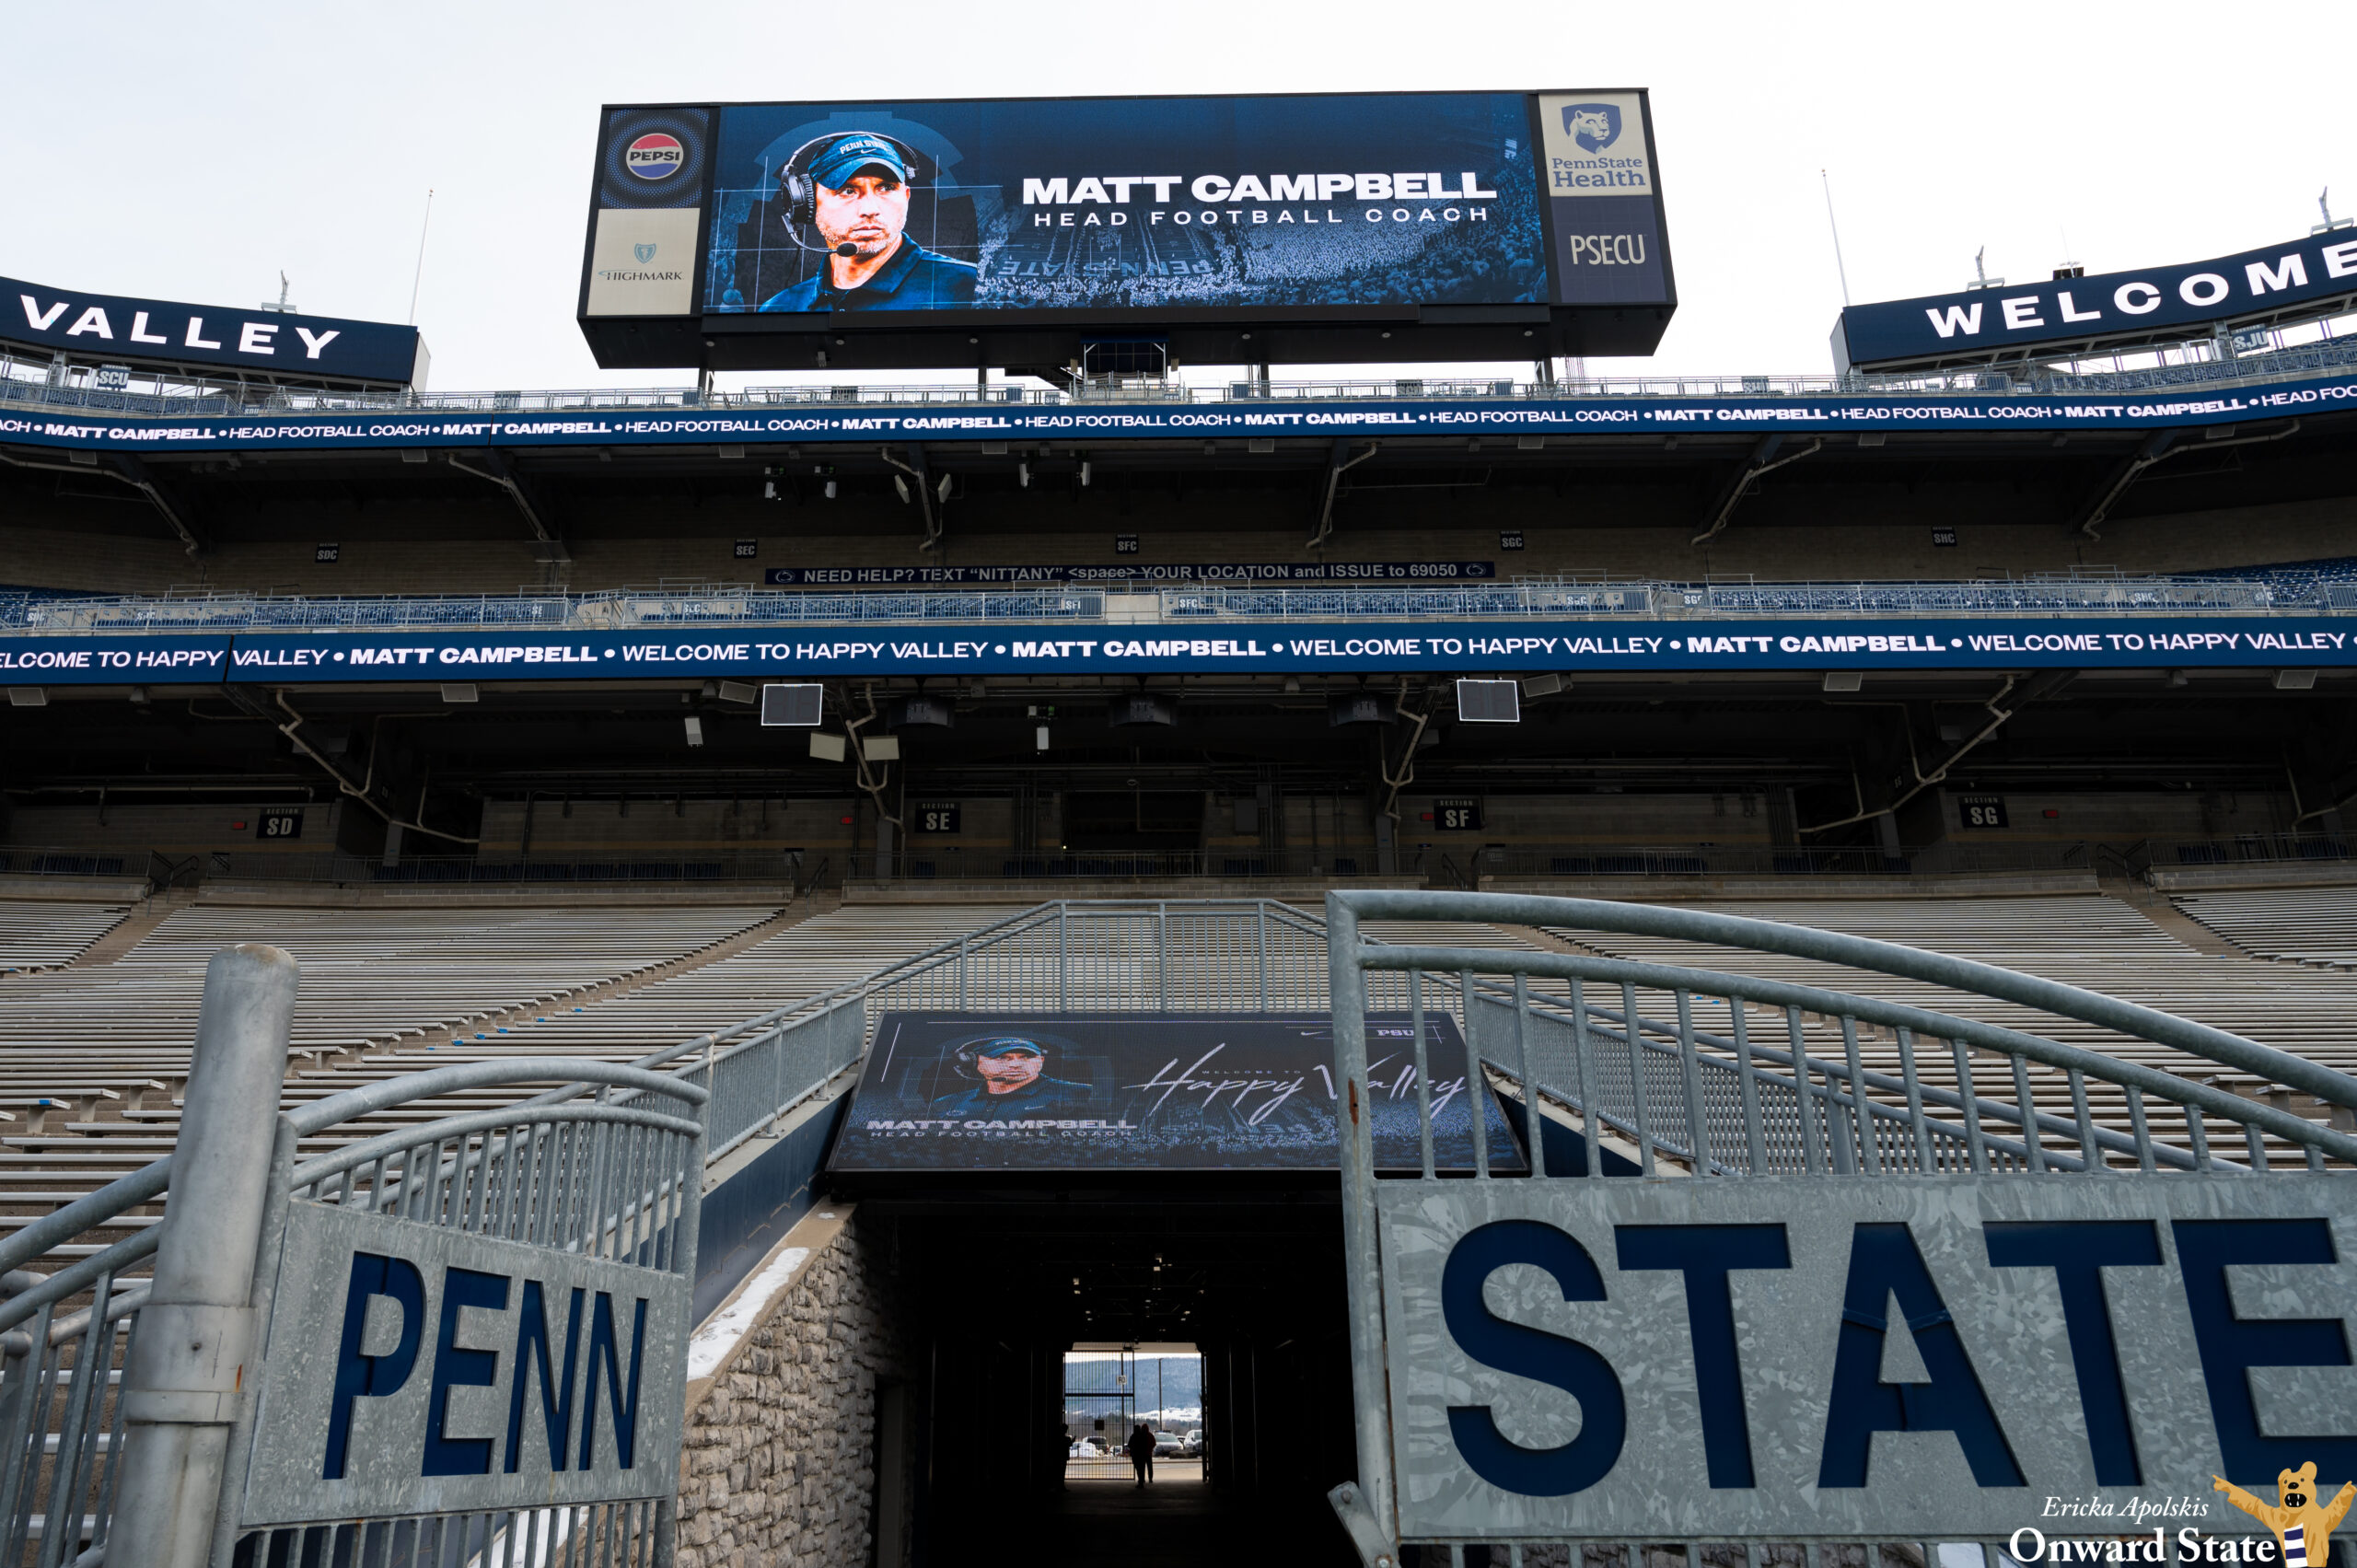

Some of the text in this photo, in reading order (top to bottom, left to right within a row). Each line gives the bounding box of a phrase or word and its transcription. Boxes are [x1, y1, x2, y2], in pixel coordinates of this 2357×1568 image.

[630, 149, 680, 162] PEPSI
[1552, 157, 1643, 168] PennState
[1553, 170, 1645, 187] Health
[1024, 173, 1496, 203] MATT CAMPBELL
[1035, 207, 1489, 226] HEAD FOOTBALL COACH
[1570, 234, 1645, 265] PSECU
[607, 271, 682, 281] HIGHMARK
[1926, 239, 2357, 338] WELCOME
[20, 295, 341, 359] VALLEY
[2234, 331, 2269, 350] SJU
[99, 371, 129, 385] SCU
[45, 424, 107, 438] MATT
[109, 428, 215, 439] CAMPBELL
[229, 427, 275, 438] HEAD
[278, 426, 366, 437] FOOTBALL
[370, 424, 429, 436] COACH
[443, 424, 502, 435] MATT
[505, 423, 611, 434] CAMPBELL
[625, 422, 672, 433] HEAD
[675, 421, 765, 432] FOOTBALL
[768, 419, 828, 430] COACH
[842, 418, 900, 429] MATT
[903, 417, 1011, 429] CAMPBELL
[1026, 416, 1073, 427] HEAD
[1076, 415, 1167, 426] FOOTBALL
[1169, 414, 1230, 425] COACH
[1245, 413, 1303, 424] MATT
[1306, 412, 1416, 424] CAMPBELL
[1430, 412, 1478, 423] HEAD
[1480, 412, 1573, 423] FOOTBALL
[1575, 411, 1637, 422] COACH
[1655, 410, 1713, 421] MATT
[1716, 409, 1829, 420] CAMPBELL
[1841, 408, 1890, 419] HEAD
[1893, 408, 1986, 418] FOOTBALL
[1989, 407, 2051, 418] COACH
[2065, 406, 2123, 417] MATT
[2127, 399, 2247, 417] CAMPBELL
[2261, 389, 2317, 407] HEAD
[1118, 540, 1137, 552] SFC
[1502, 537, 1523, 548] SGC
[1933, 533, 1955, 544] SHC
[317, 550, 337, 560] SDC
[737, 545, 755, 555] SEC
[804, 570, 852, 583] NEED
[857, 569, 914, 582] HELP?
[920, 568, 966, 581] TEXT
[1068, 566, 1136, 581] <space>
[1141, 566, 1192, 579] YOUR
[1198, 565, 1289, 579] LOCATION
[1295, 565, 1324, 578] and
[1330, 564, 1383, 578] ISSUE
[1388, 565, 1405, 577] to
[1409, 563, 1457, 577] 69050
[1179, 598, 1198, 608] SFC
[98, 652, 131, 667] TO
[136, 651, 224, 667] HAPPY
[233, 650, 328, 665] VALLEY
[350, 648, 435, 664] MATT
[439, 646, 598, 663] CAMPBELL
[622, 645, 749, 661] WELCOME
[756, 644, 790, 659] TO
[796, 644, 885, 658] HAPPY
[890, 643, 988, 657] VALLEY
[1013, 642, 1097, 656] MATT
[1104, 641, 1266, 656] CAMPBELL
[1290, 639, 1421, 656] WELCOME
[1426, 639, 1462, 655] TO
[1469, 638, 1557, 654] HAPPY
[1563, 637, 1662, 653] VALLEY
[1688, 637, 1772, 653] MATT
[1780, 636, 1945, 652] CAMPBELL
[1968, 634, 2102, 651] WELCOME
[2106, 634, 2143, 650] TO
[2149, 633, 2239, 649] HAPPY
[2245, 633, 2345, 649] VALLEY
[926, 812, 950, 830] SE
[1446, 809, 1469, 828] SF
[1969, 807, 1999, 826] SG
[267, 818, 293, 835] SD
[1120, 1042, 1305, 1125] Happy
[866, 1120, 1138, 1131] MATT CAMPBELL
[322, 1250, 649, 1481] PENN
[1441, 1218, 2357, 1497] STATE
